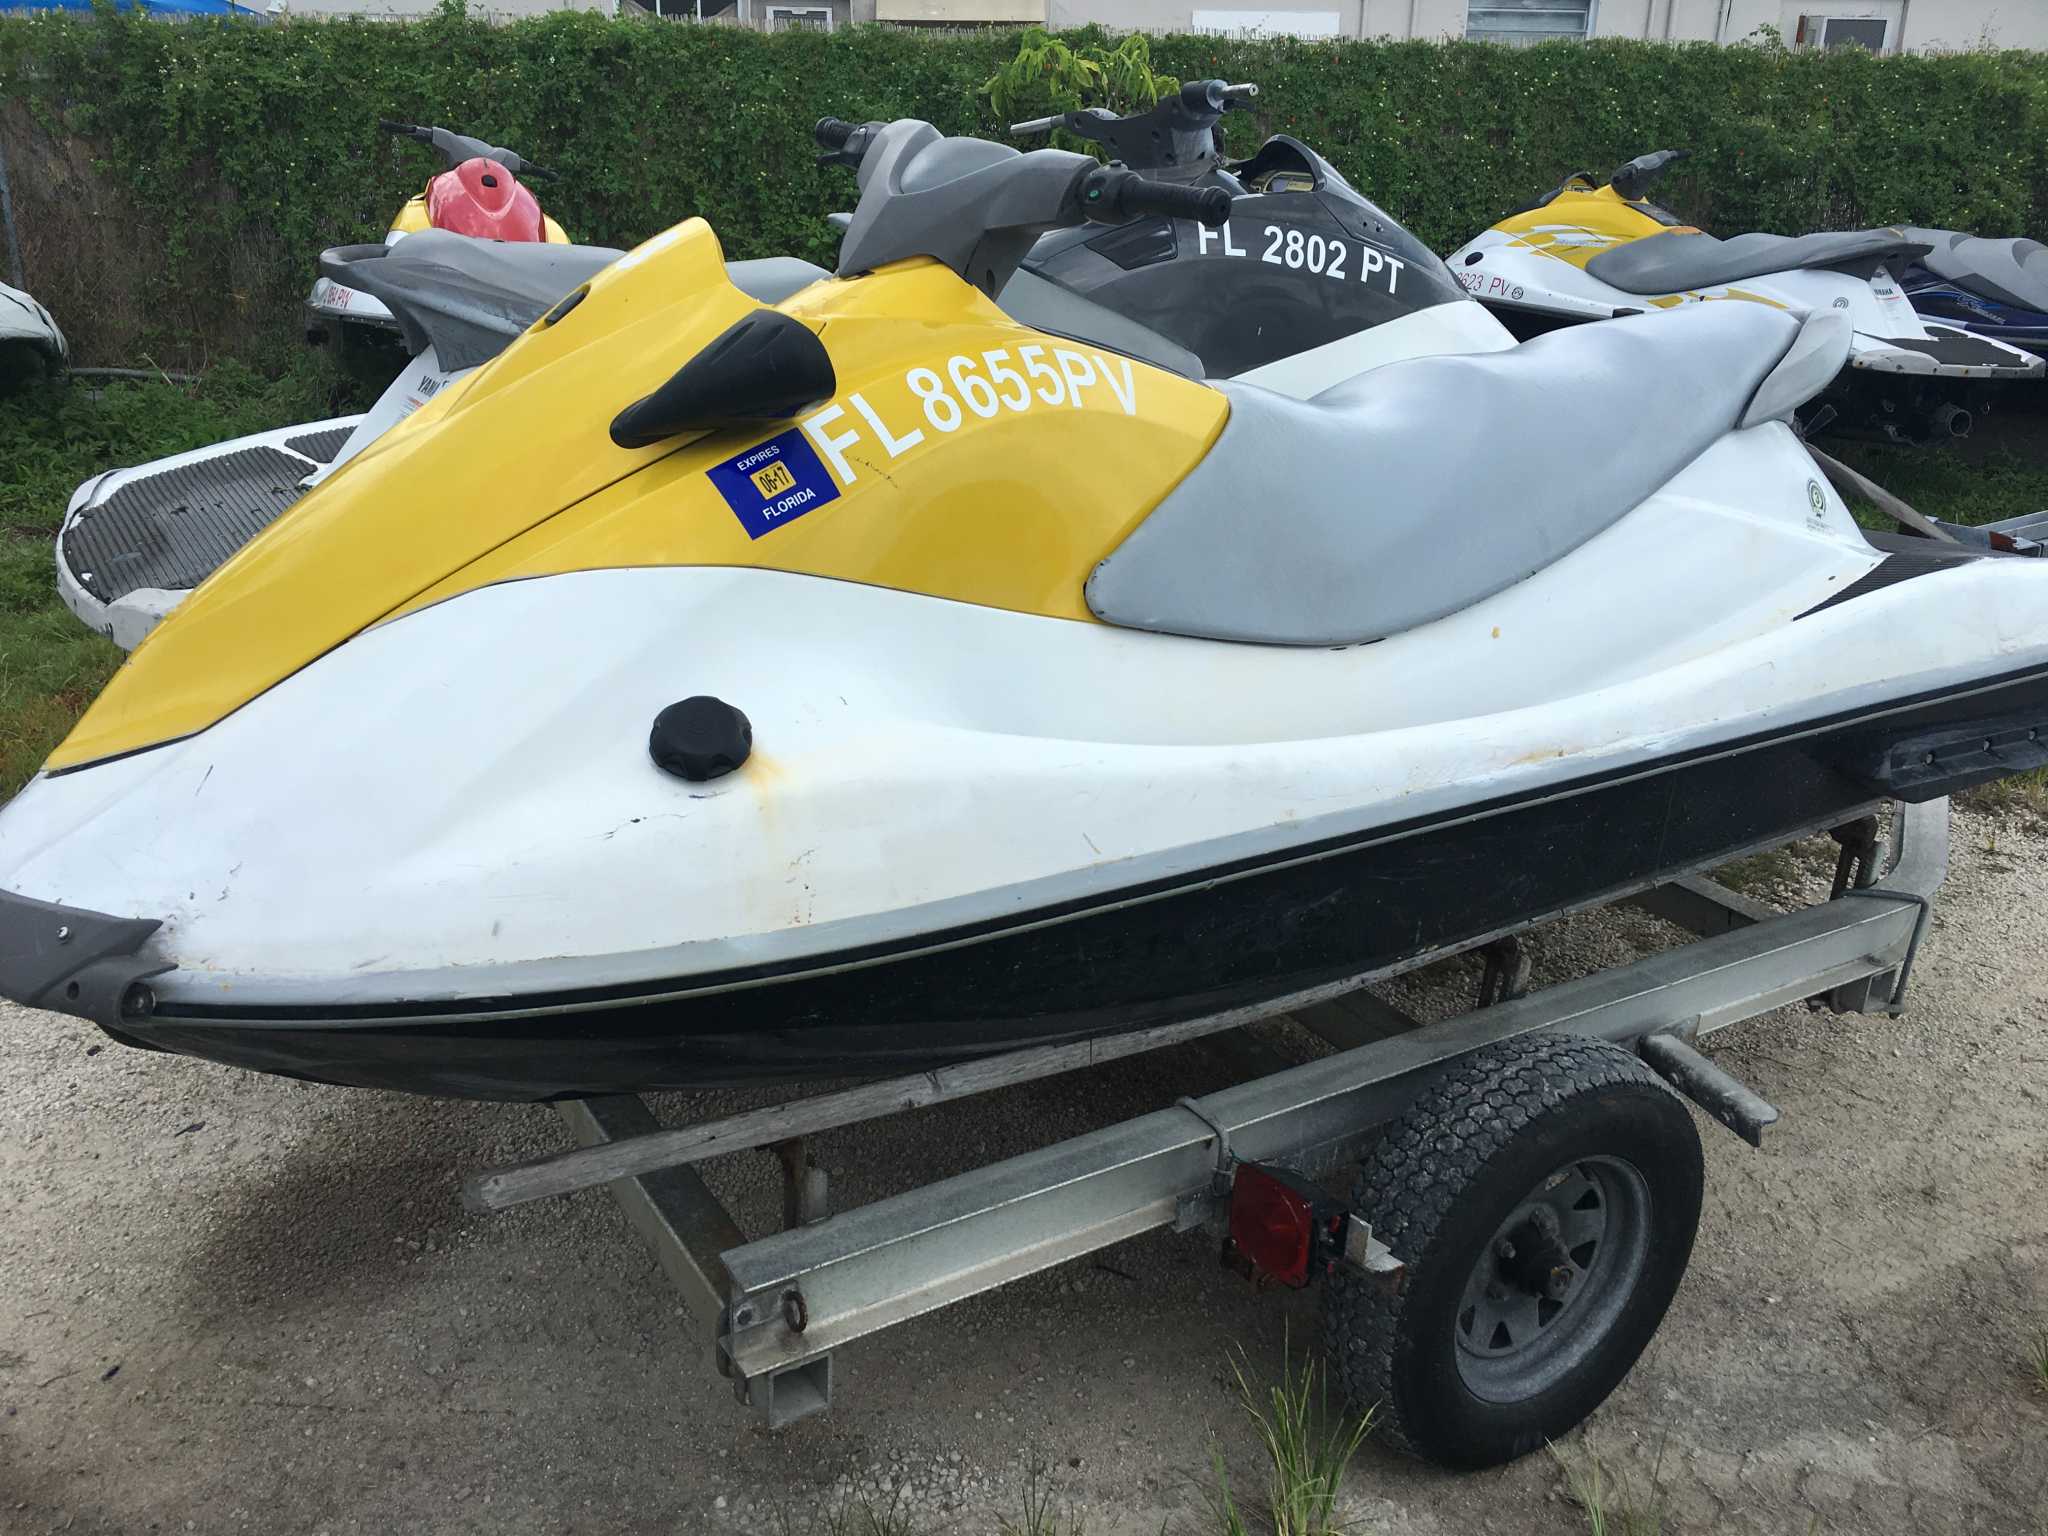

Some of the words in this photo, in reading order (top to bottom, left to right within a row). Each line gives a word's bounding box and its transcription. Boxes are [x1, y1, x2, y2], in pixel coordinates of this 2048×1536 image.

[1197, 218, 1247, 257] FL
[1261, 225, 1347, 280] 2802
[1360, 245, 1405, 295] PT
[1488, 276, 1510, 297] PV
[737, 445, 780, 471] EXPIRES
[759, 465, 790, 494] 06-17
[762, 487, 817, 521] FLORIDA
